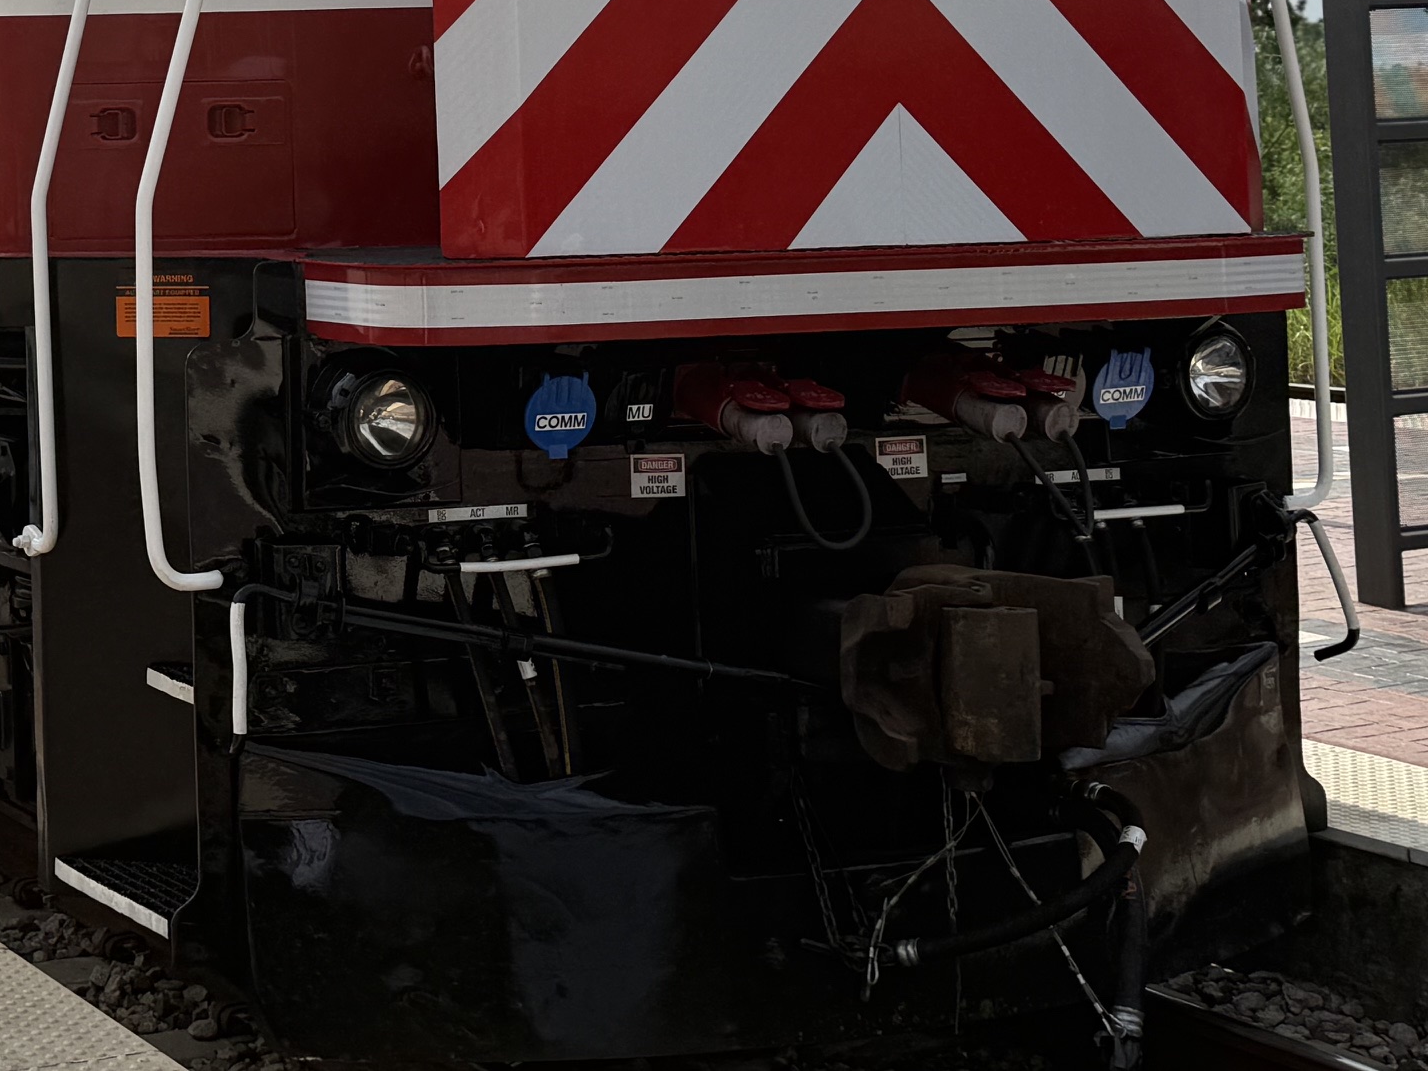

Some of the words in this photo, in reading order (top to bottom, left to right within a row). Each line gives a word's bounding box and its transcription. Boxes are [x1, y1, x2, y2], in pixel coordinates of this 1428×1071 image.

[153, 274, 193, 282] WARNING
[1101, 387, 1144, 402] COMM
[627, 405, 652, 420] MU
[536, 414, 586, 429] COMM
[886, 443, 917, 452] DANGER
[641, 460, 674, 470] DANGER
[892, 457, 912, 466] HIGH
[647, 475, 669, 484] HIGH
[639, 485, 677, 495] VOLTAGE
[469, 507, 486, 518] ACT
[505, 506, 519, 516] MR
